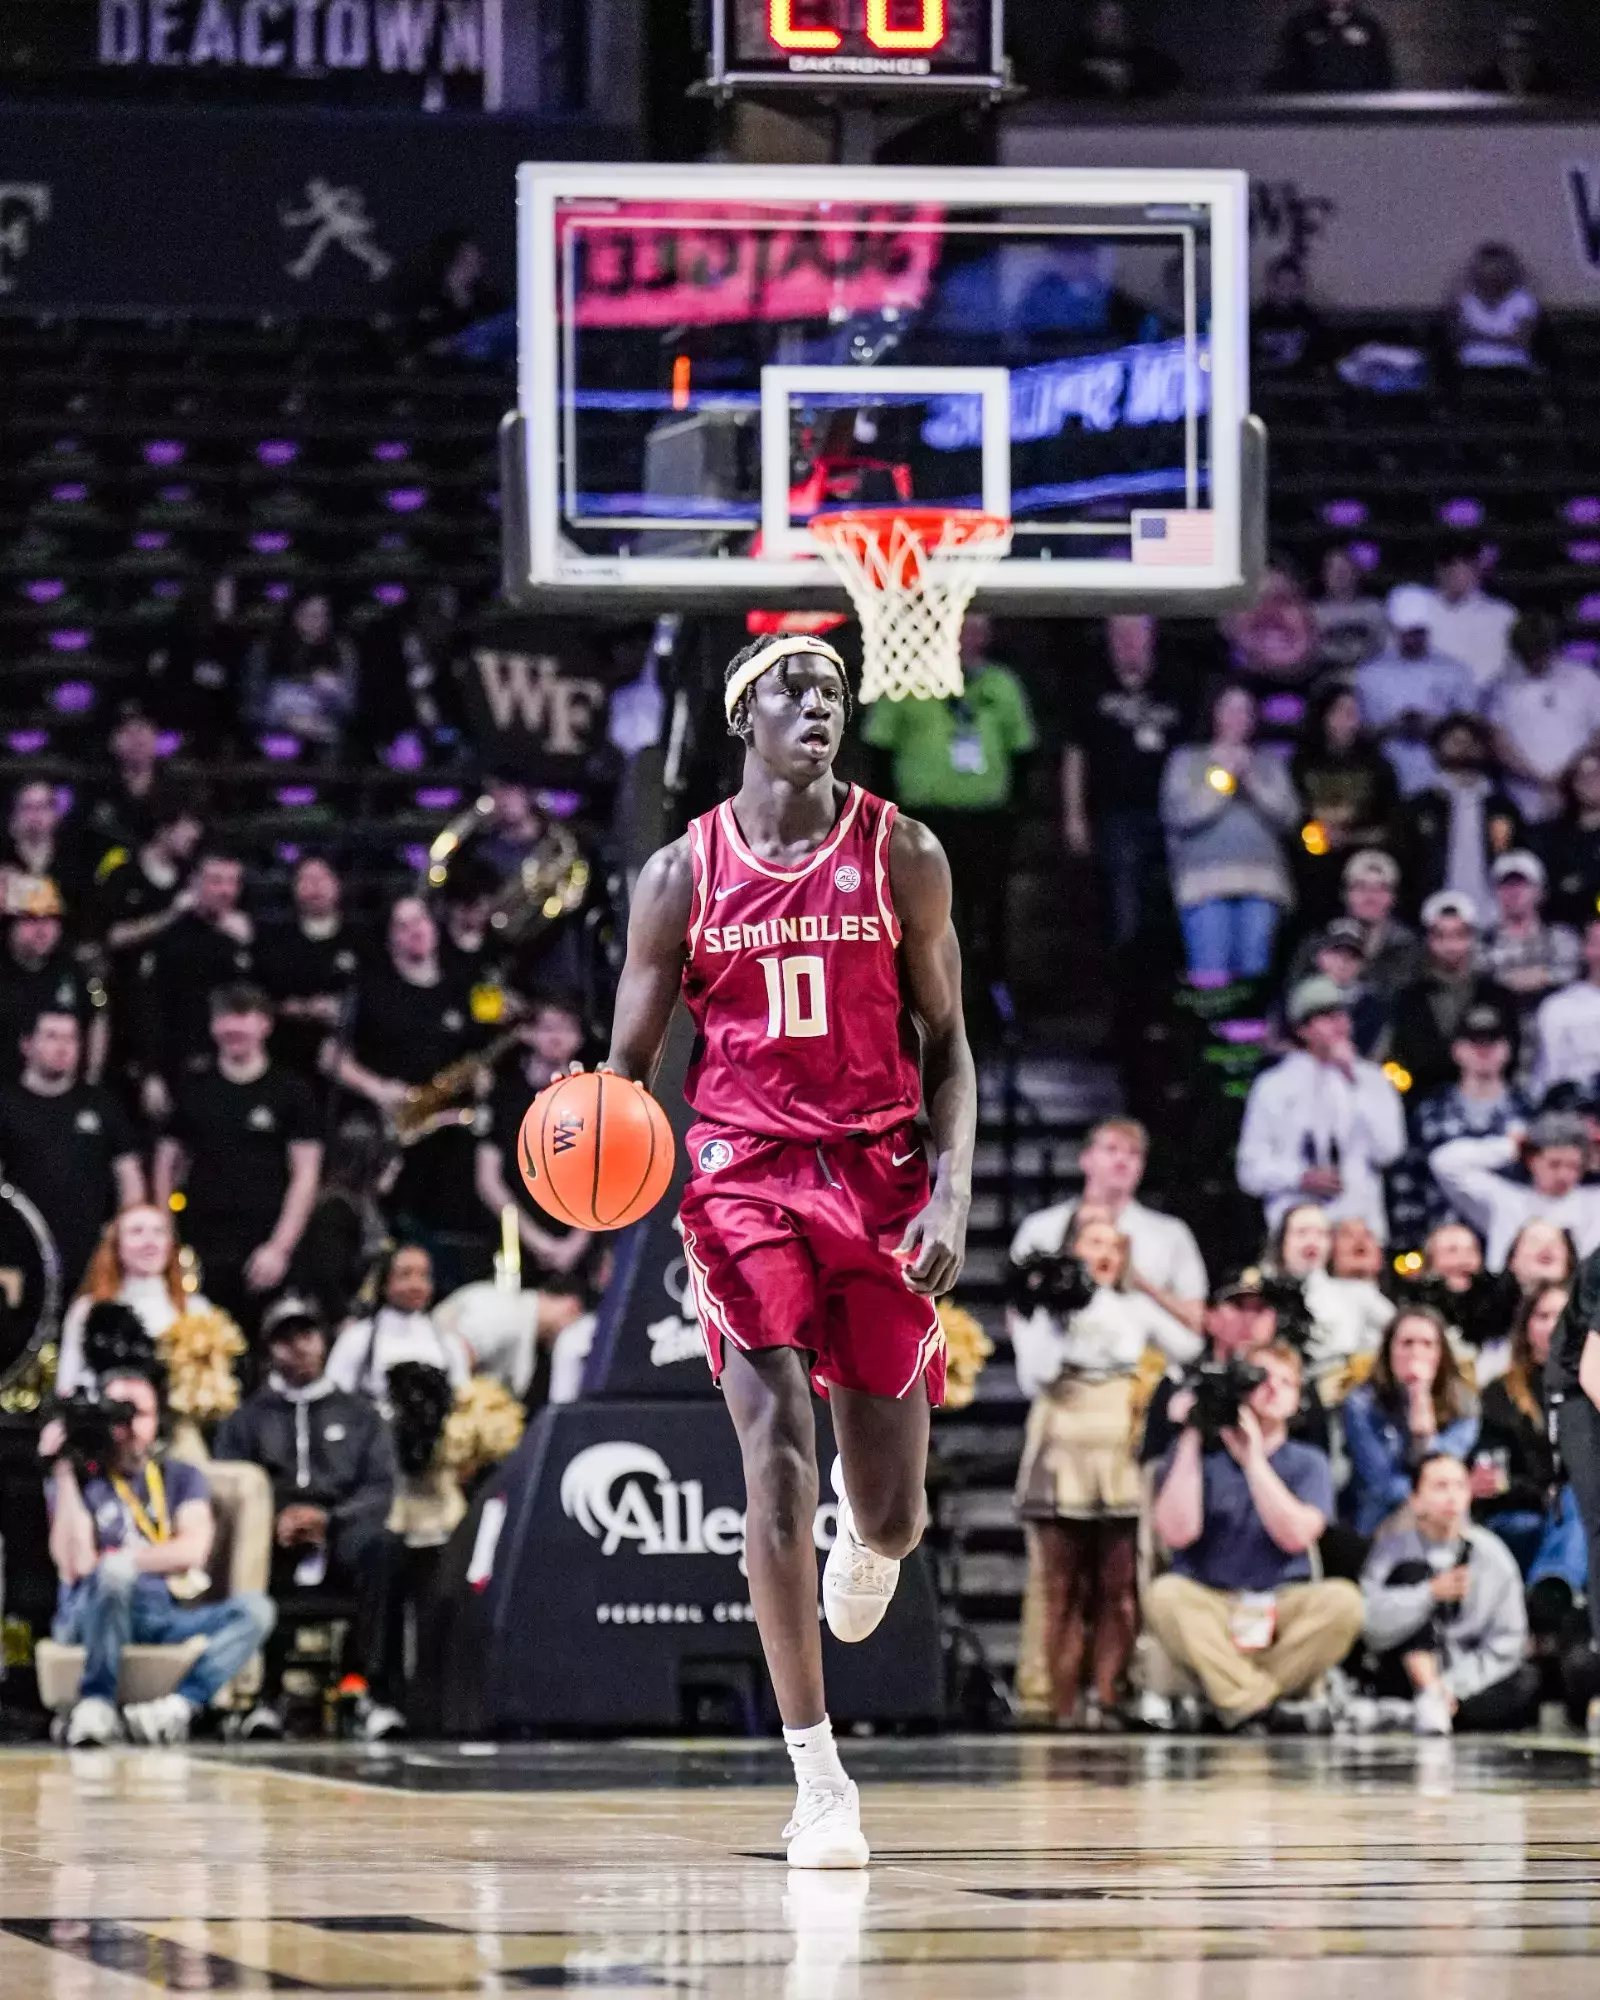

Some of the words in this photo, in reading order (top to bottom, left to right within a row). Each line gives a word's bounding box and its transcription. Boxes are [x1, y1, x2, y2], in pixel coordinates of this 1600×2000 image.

[98, 0, 482, 72] DEACTOWN
[472, 651, 604, 754] WF
[704, 915, 881, 953] SEMINOLES
[756, 955, 828, 1038] 10
